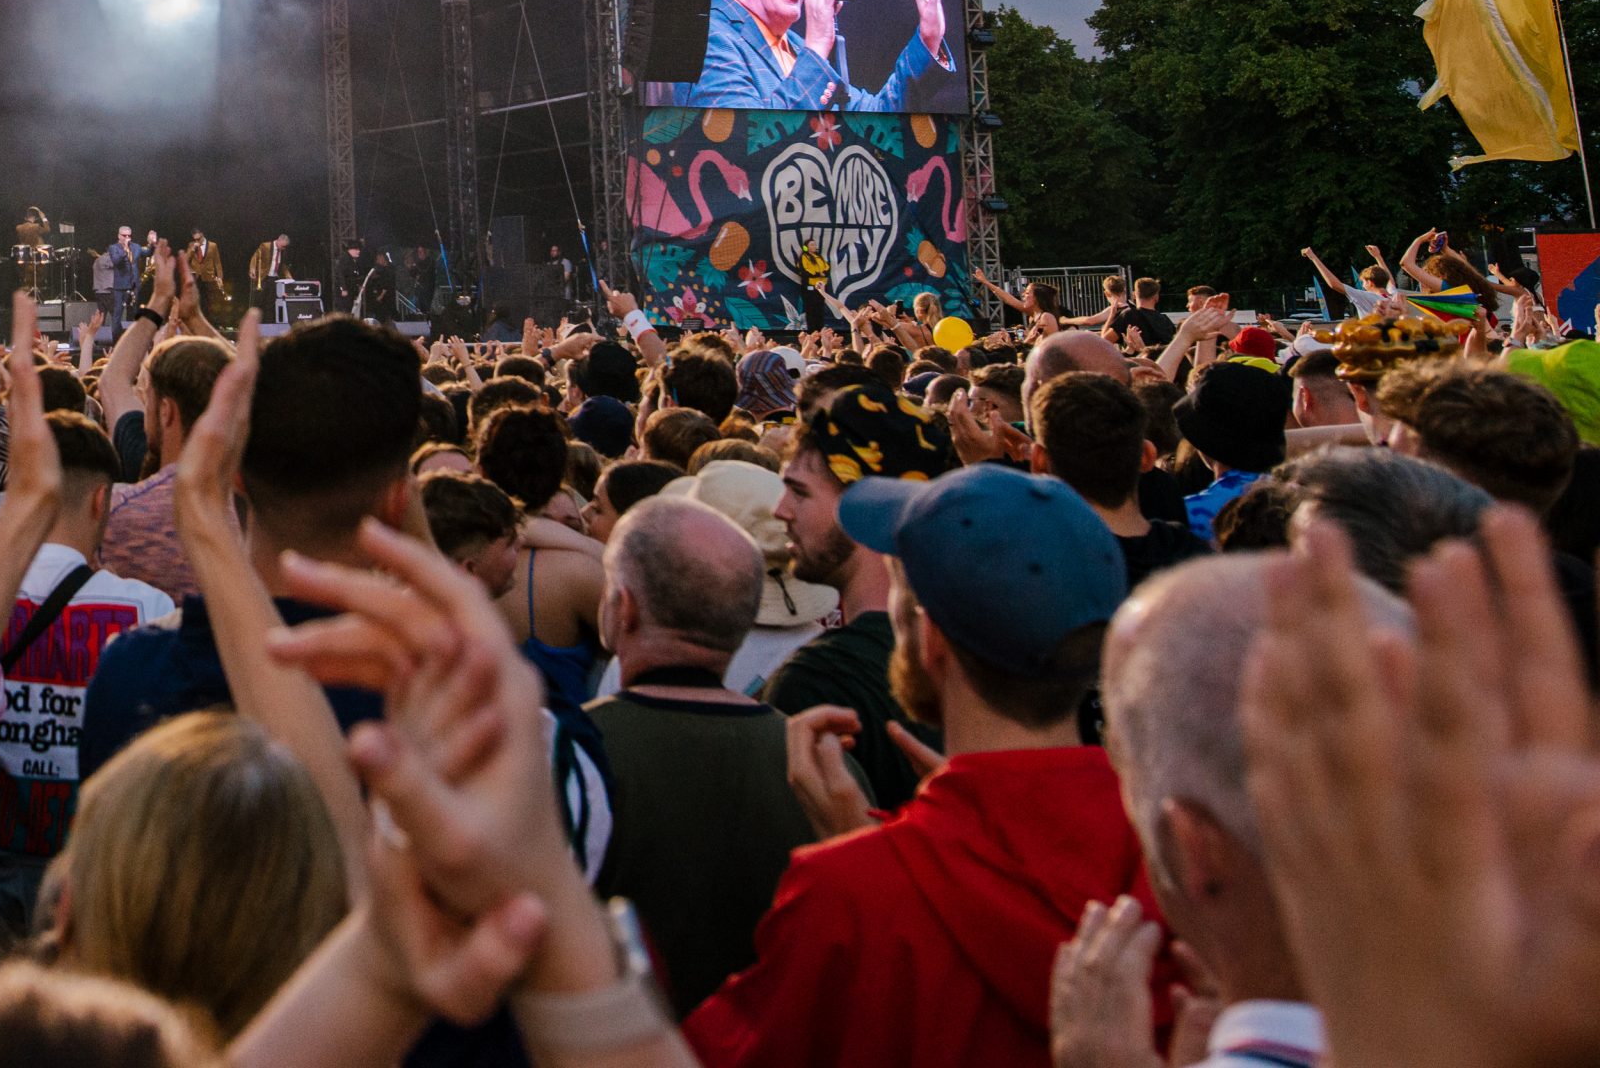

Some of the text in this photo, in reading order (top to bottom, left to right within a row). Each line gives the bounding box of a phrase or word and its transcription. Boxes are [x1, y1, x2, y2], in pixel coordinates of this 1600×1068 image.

[775, 157, 892, 226] BE MORE
[38, 686, 81, 715] for
[22, 758, 61, 777] CALL:
